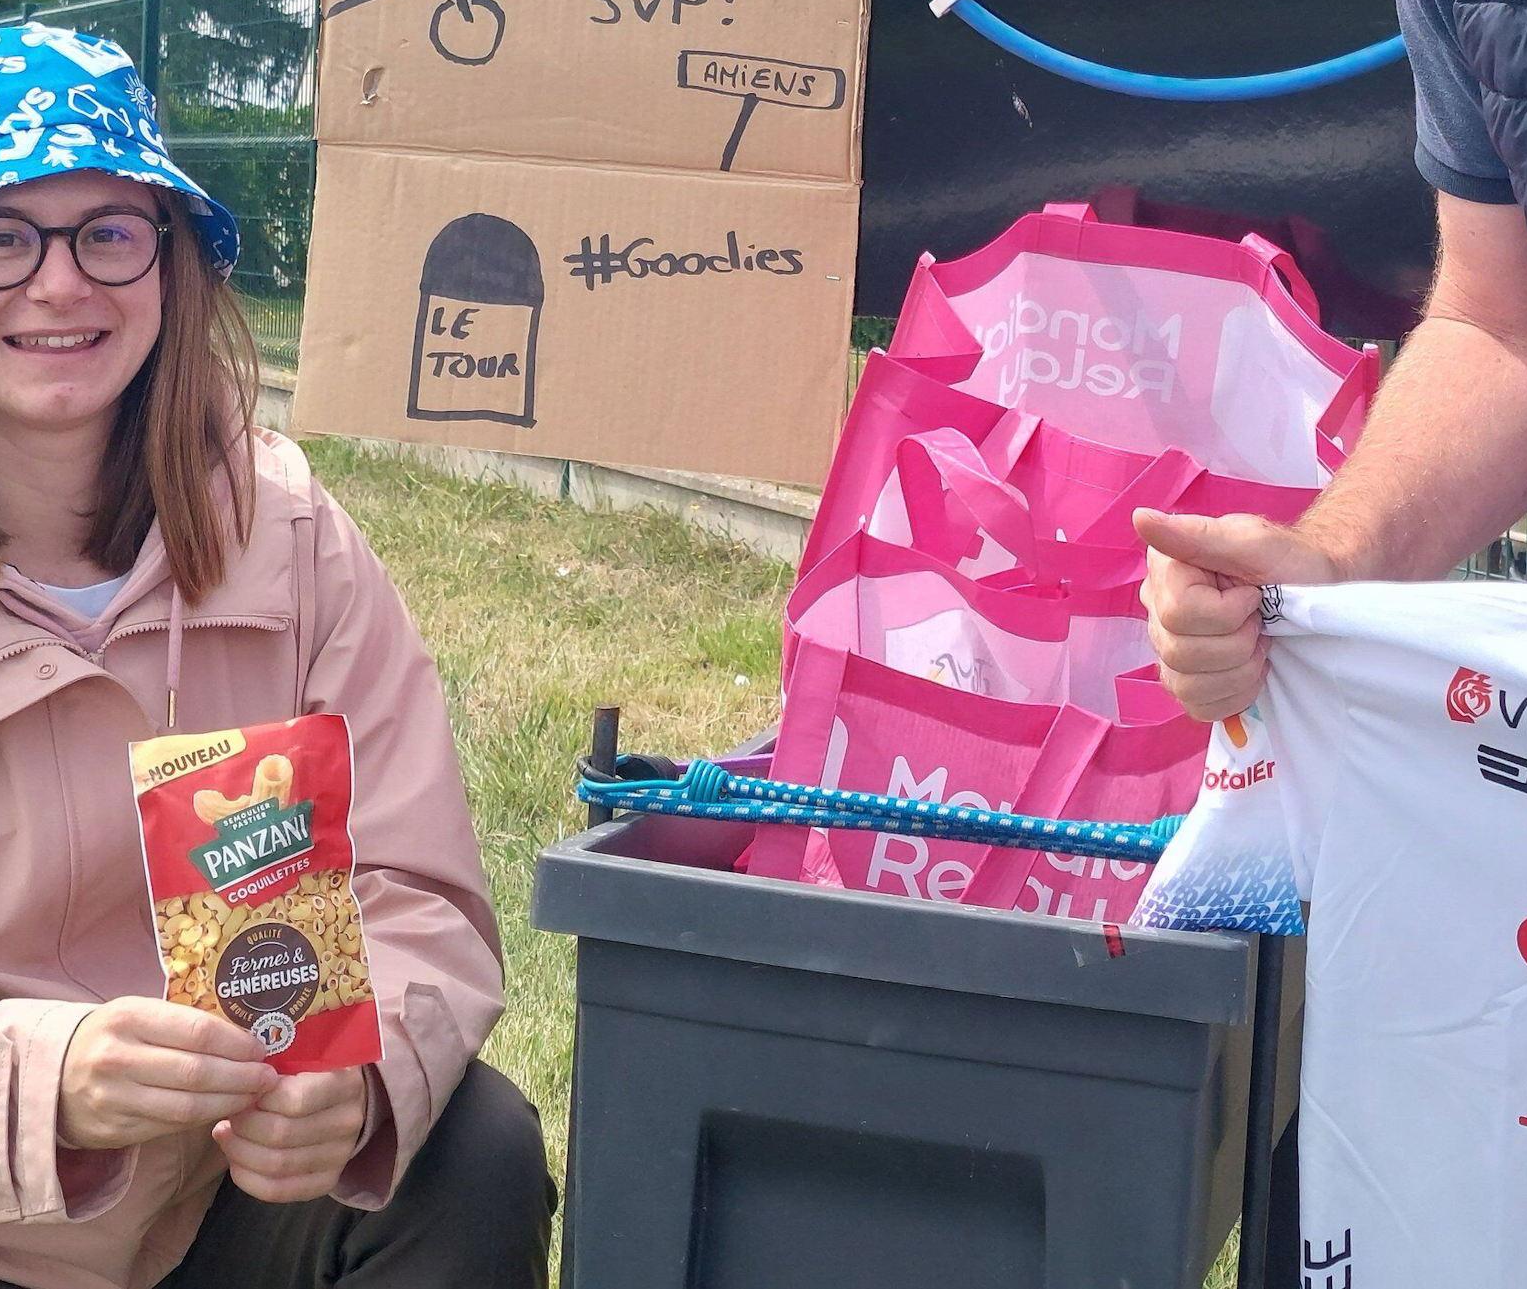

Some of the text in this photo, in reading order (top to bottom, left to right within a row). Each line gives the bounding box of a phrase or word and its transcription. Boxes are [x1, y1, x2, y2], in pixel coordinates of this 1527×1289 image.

[563, 231, 804, 291] #Goodies
[429, 308, 481, 340] LE
[426, 350, 521, 381] TOUR
[148, 740, 232, 782] NOUVEAU
[223, 803, 271, 828] SEMOULIER
[232, 812, 267, 831] PASTIER
[203, 813, 309, 880] PANZANI
[227, 858, 311, 904] COQUILLETTES
[246, 927, 283, 946] QUALITÉ
[229, 947, 306, 975] Fermes &
[217, 963, 320, 1000] GÉNÉREUSES
[288, 986, 313, 1015] BRONZE
